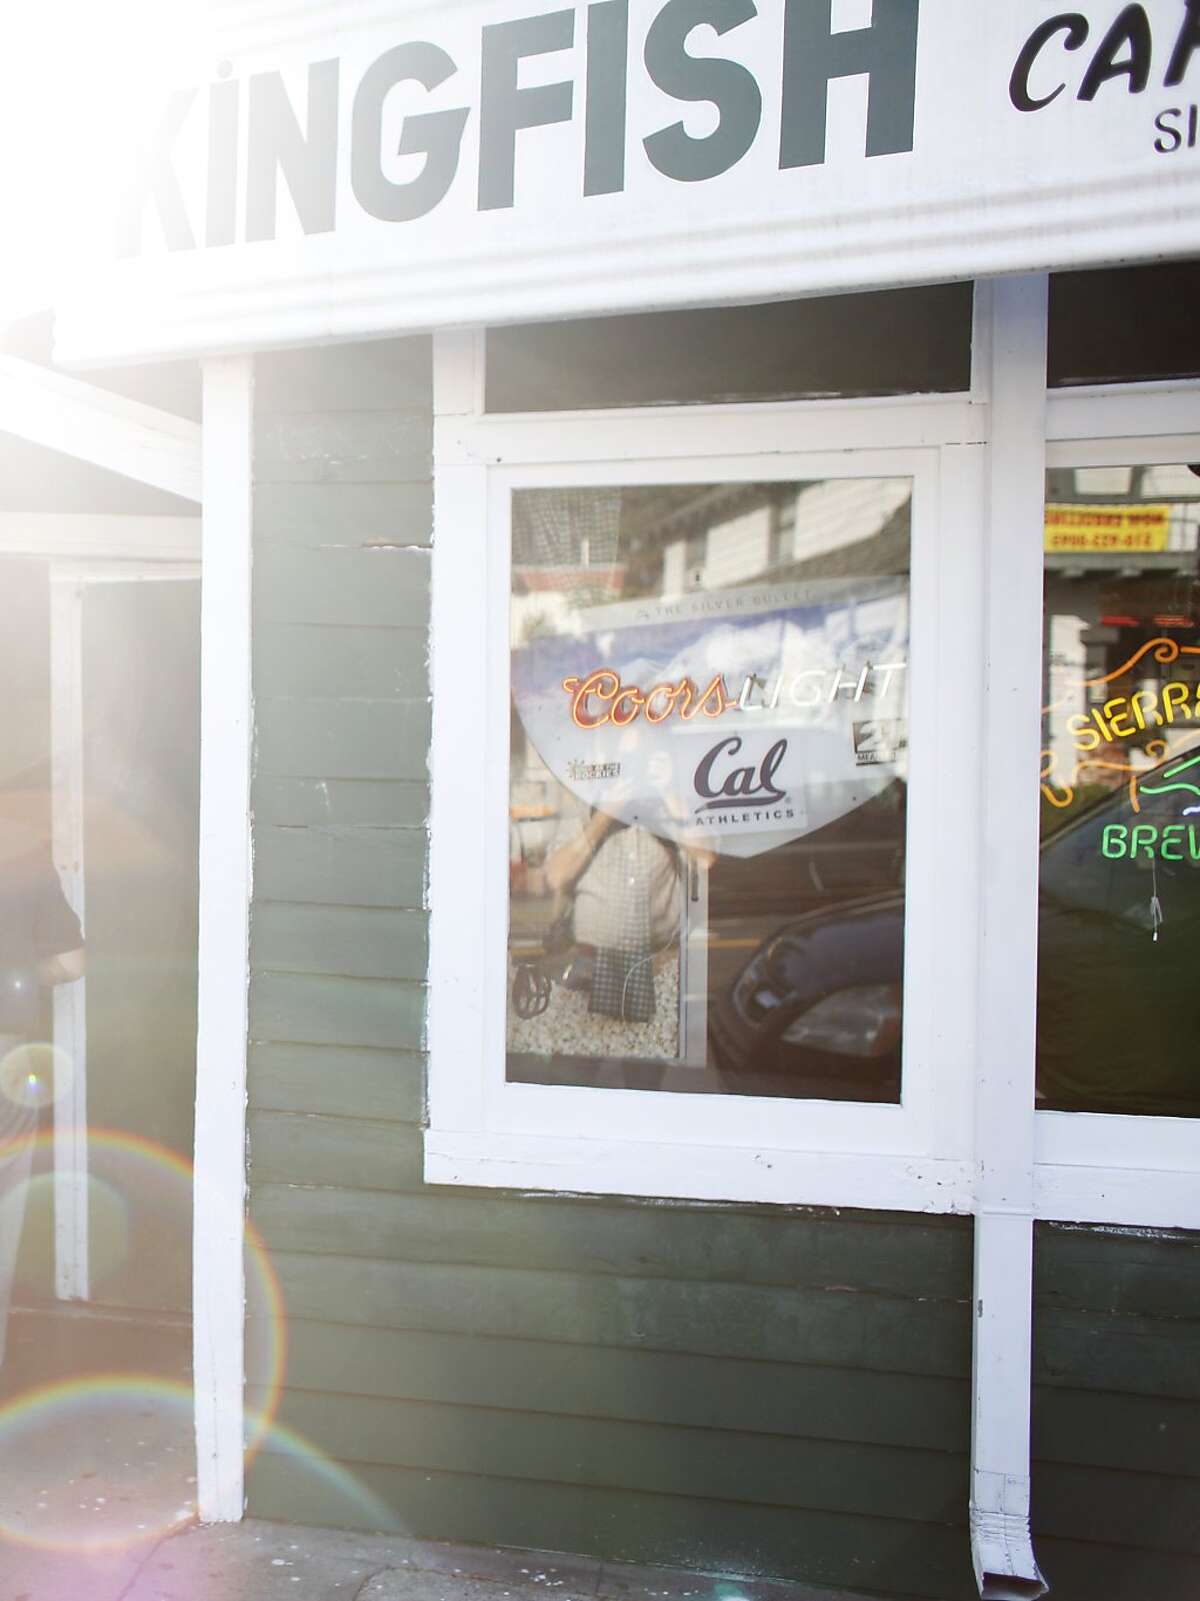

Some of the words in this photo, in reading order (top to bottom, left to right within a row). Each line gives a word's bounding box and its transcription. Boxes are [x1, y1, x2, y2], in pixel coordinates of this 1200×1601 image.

[562, 668, 736, 729] Coors
[738, 662, 907, 713] LIGHT
[1066, 682, 1200, 751] SIERR
[694, 736, 788, 801] Cal
[695, 808, 795, 826] ATHLETICS
